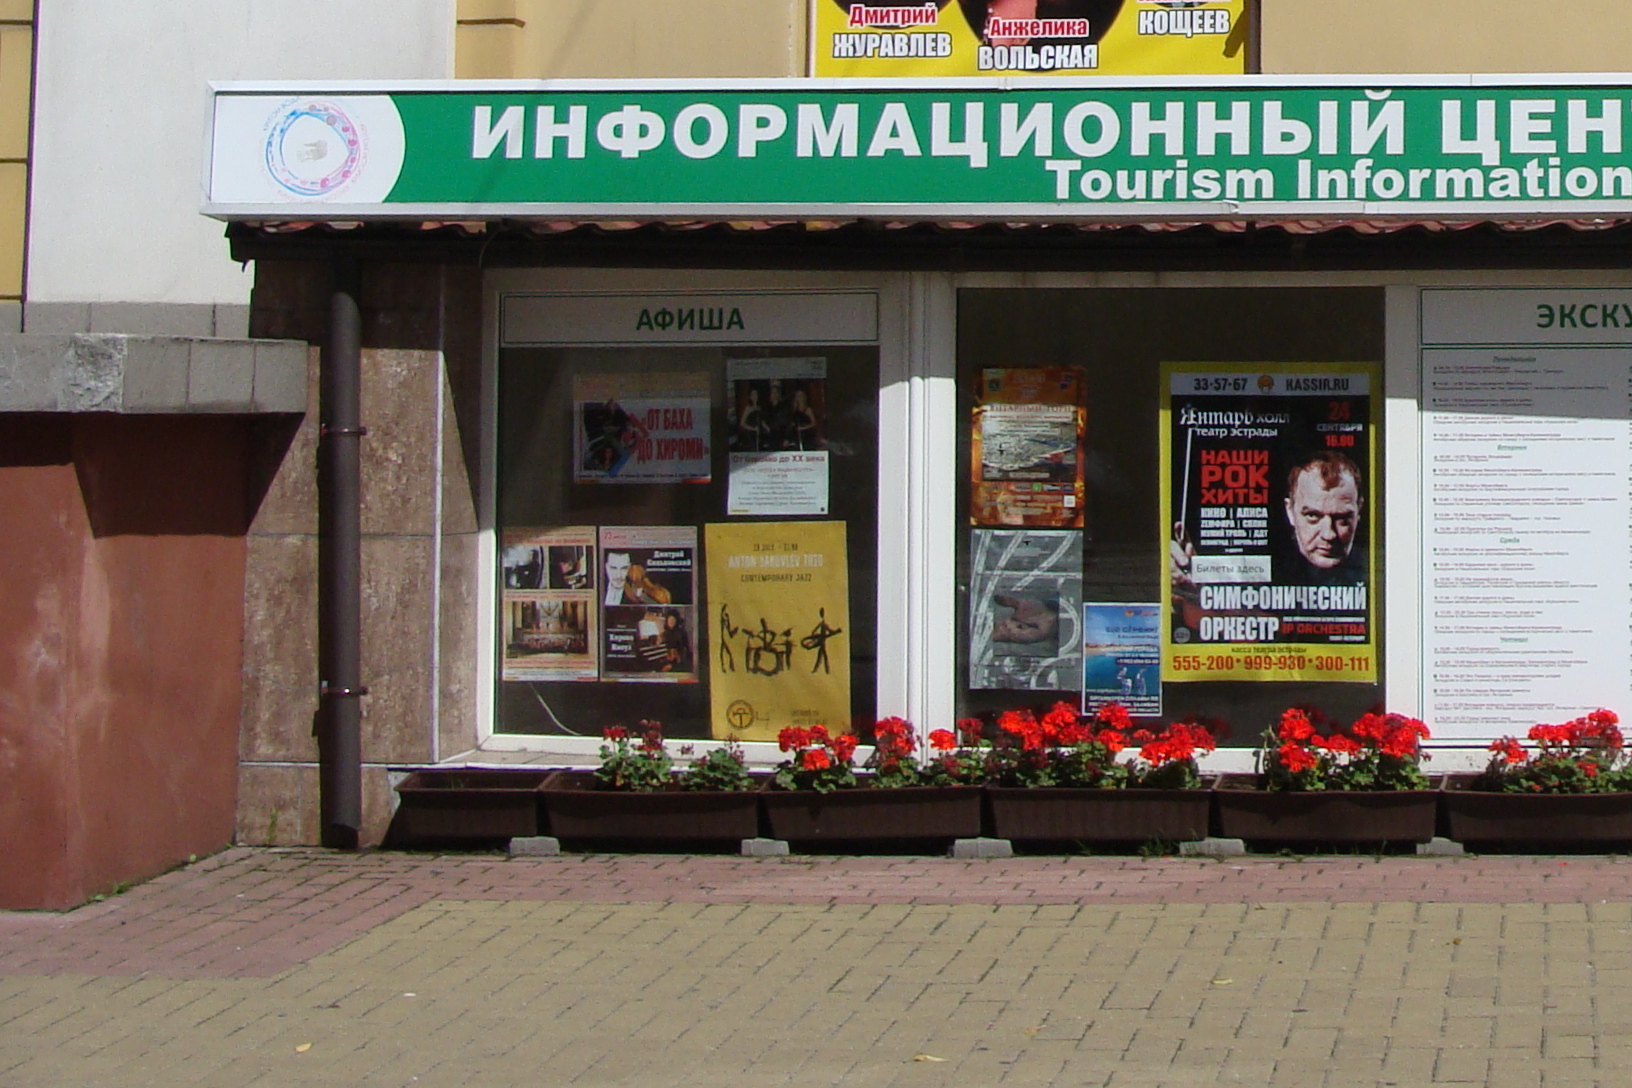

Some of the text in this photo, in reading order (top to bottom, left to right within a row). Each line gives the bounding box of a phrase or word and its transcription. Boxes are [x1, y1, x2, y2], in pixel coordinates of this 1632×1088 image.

[849, 2, 939, 29] Дмитрий
[1137, 7, 1232, 39] КОЩЕЕВ
[988, 17, 1091, 40] Анжелика
[831, 31, 953, 59] ЖУРАВЛЕВ
[975, 43, 1099, 73] ВОЛЬСКАЯ
[472, 89, 1406, 169] ИНФОРМАЦИОННЫЙ
[1044, 158, 1275, 201] Tourism
[635, 306, 746, 331] АФИША
[1285, 377, 1350, 392] KASSIR.RU
[663, 407, 694, 430] БАХА
[1195, 427, 1278, 439] театр эстрады
[1201, 449, 1269, 465] НАШИ
[1201, 464, 1270, 489] РОК
[1201, 488, 1269, 505] ХИТЫ
[1200, 507, 1269, 519] КИНО АЛИСА
[740, 574, 794, 583] CONTEMPORARY
[1196, 564, 1265, 574] Билеты здесь
[1199, 582, 1367, 611] СИМФОНИЧЕСКИЙ
[1200, 616, 1280, 642] ОРКЕСТР
[1296, 623, 1367, 635] ORCHESTRA
[1172, 655, 1235, 671] 555-200
[1243, 655, 1306, 671] 999-930
[1315, 655, 1370, 671] 300-111
